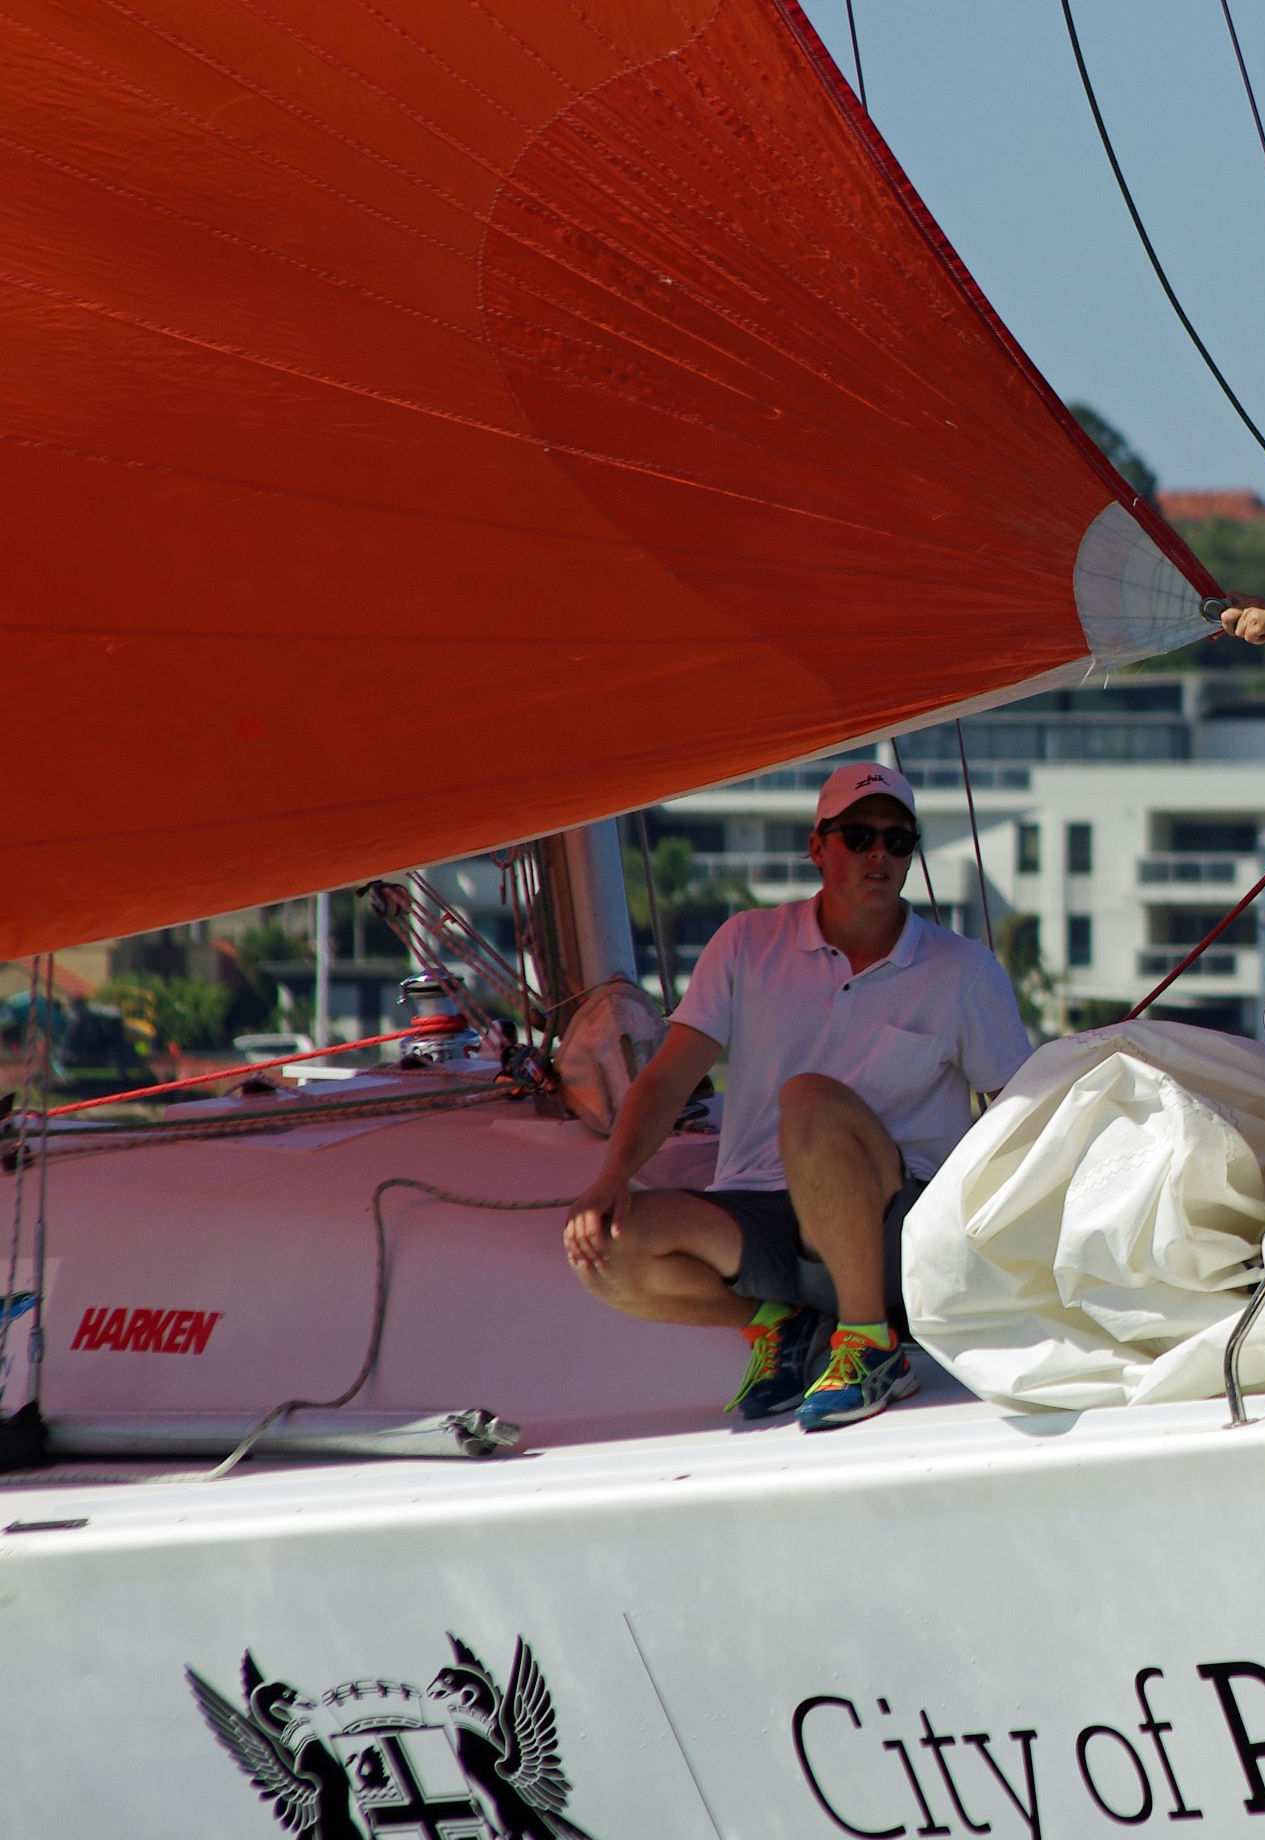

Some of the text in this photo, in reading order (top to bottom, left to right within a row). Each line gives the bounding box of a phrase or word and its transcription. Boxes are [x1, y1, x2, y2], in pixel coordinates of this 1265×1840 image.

[70, 1307, 221, 1355] HARKEN
[792, 1695, 1041, 1840] City
[1075, 1667, 1203, 1825] of
